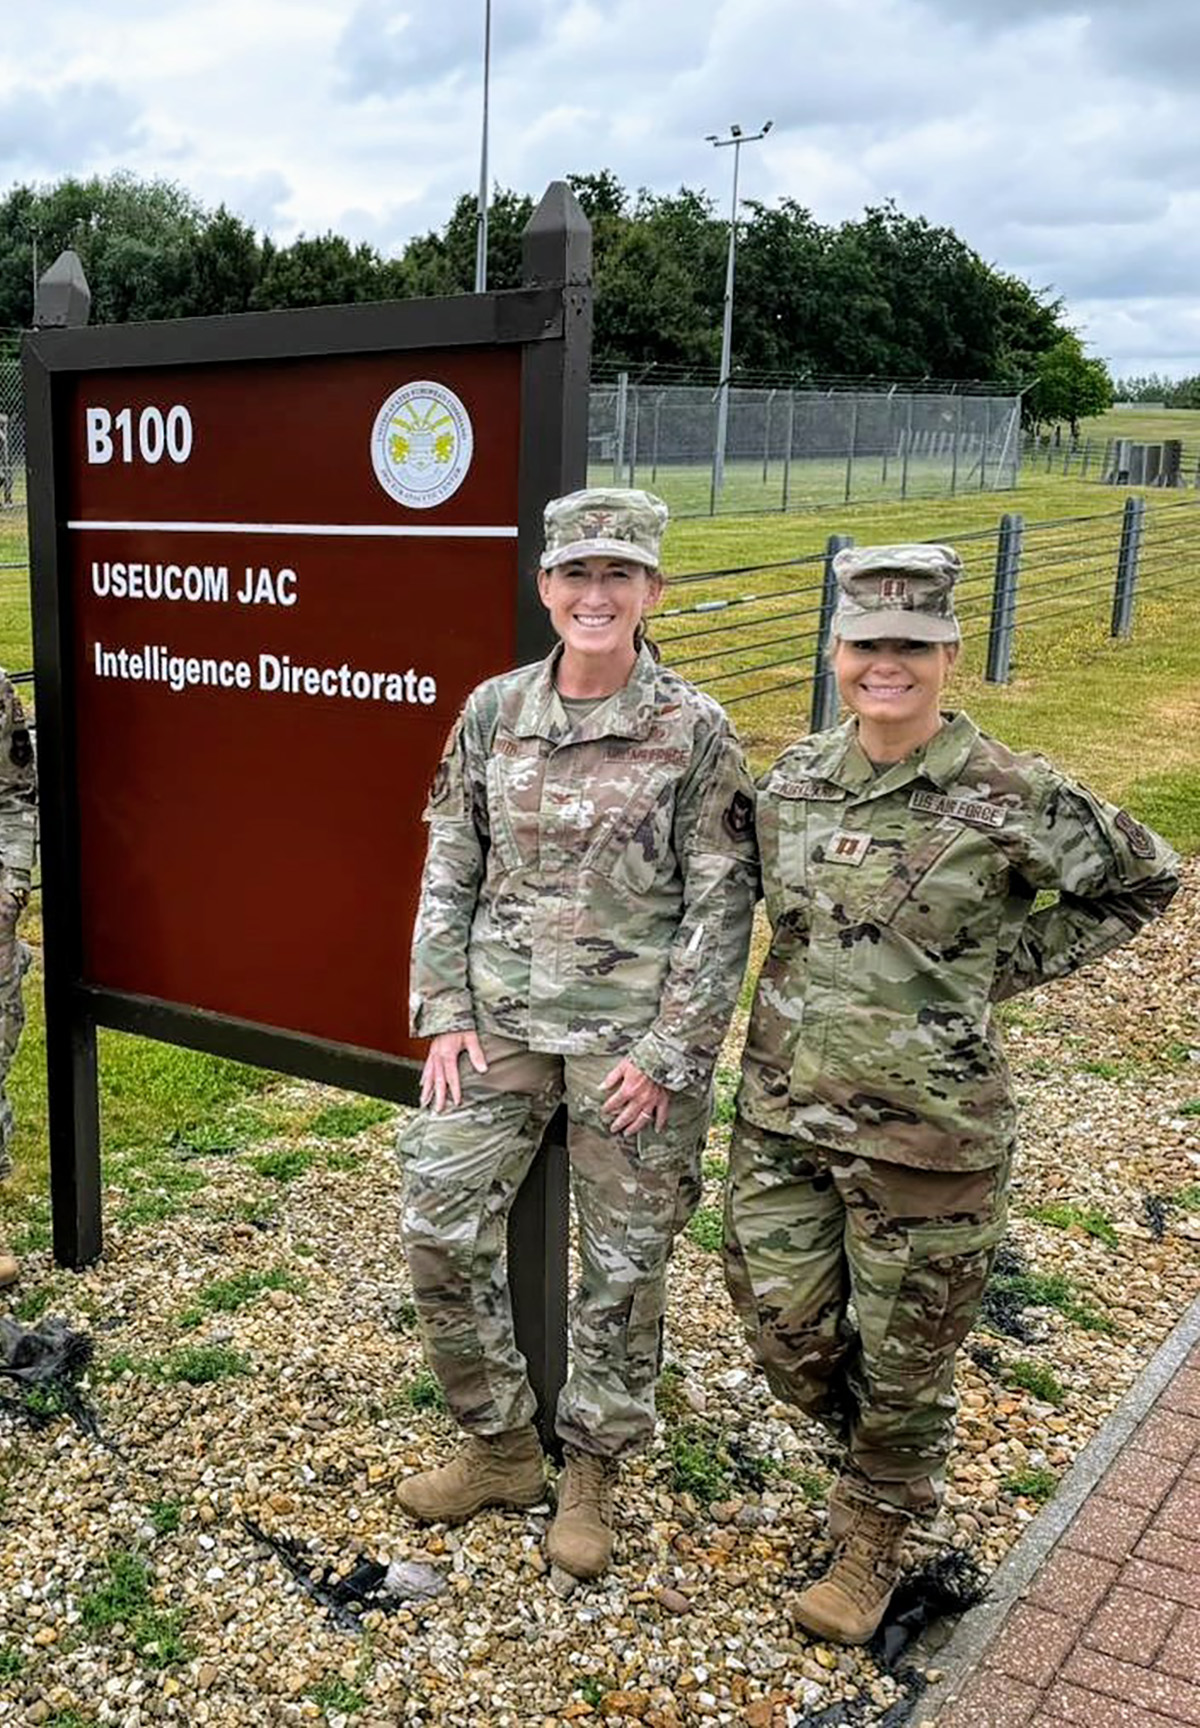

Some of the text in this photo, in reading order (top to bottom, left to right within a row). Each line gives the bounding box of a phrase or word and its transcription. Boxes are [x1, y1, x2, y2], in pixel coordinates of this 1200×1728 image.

[86, 404, 193, 464] B100
[92, 562, 297, 607] USEUCOM JAC
[94, 641, 437, 705] Intelligence Directorate
[934, 797, 957, 815] AIR
[958, 803, 1001, 825] FORCE
